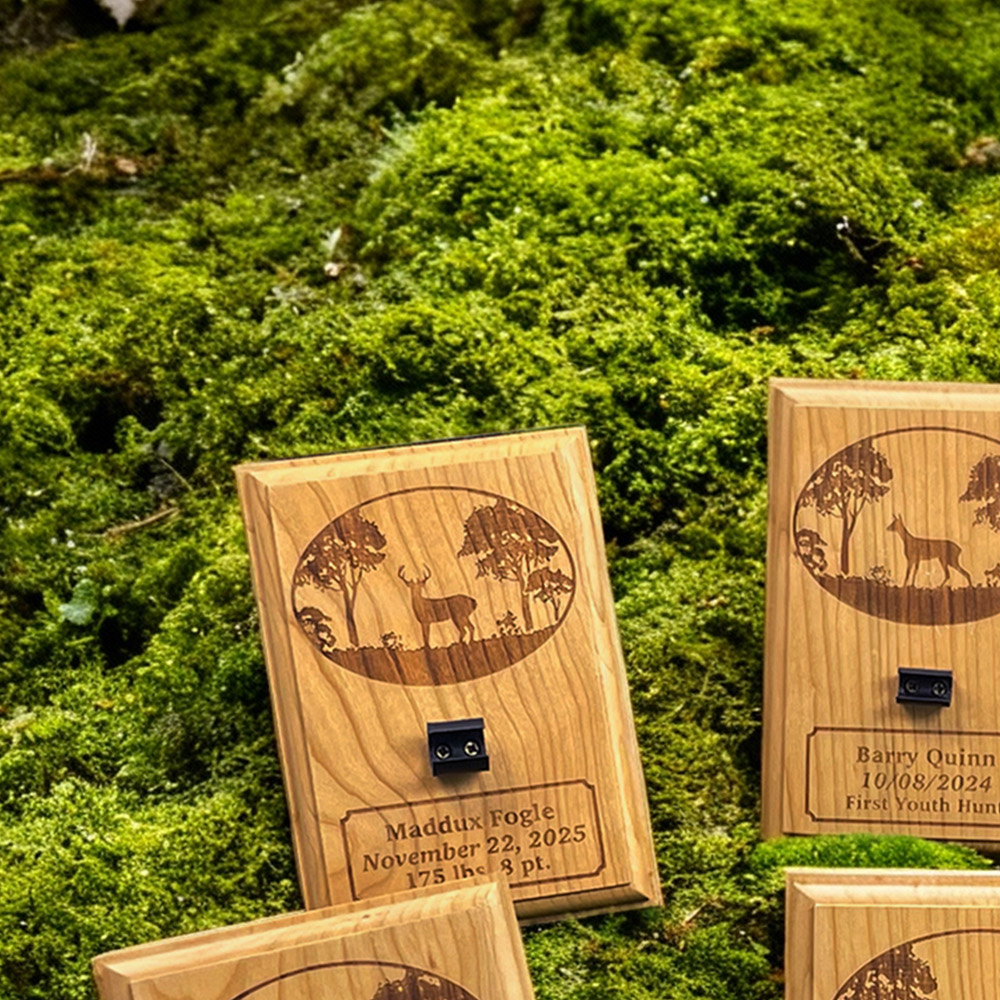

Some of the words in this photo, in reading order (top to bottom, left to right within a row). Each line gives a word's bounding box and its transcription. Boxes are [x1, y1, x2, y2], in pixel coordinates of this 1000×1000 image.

[856, 746, 918, 769] Barry
[927, 748, 996, 769] Quinn
[861, 772, 992, 793] 10/08/2024
[846, 795, 888, 811] First
[896, 796, 951, 813] Youth
[385, 815, 484, 842] Maddux
[490, 804, 555, 828] Fogle
[363, 841, 480, 872] November
[487, 835, 522, 855] 22,
[529, 824, 587, 849] 2025
[406, 868, 446, 888] 175
[501, 858, 513, 875] 8
[521, 855, 551, 877] pt.
